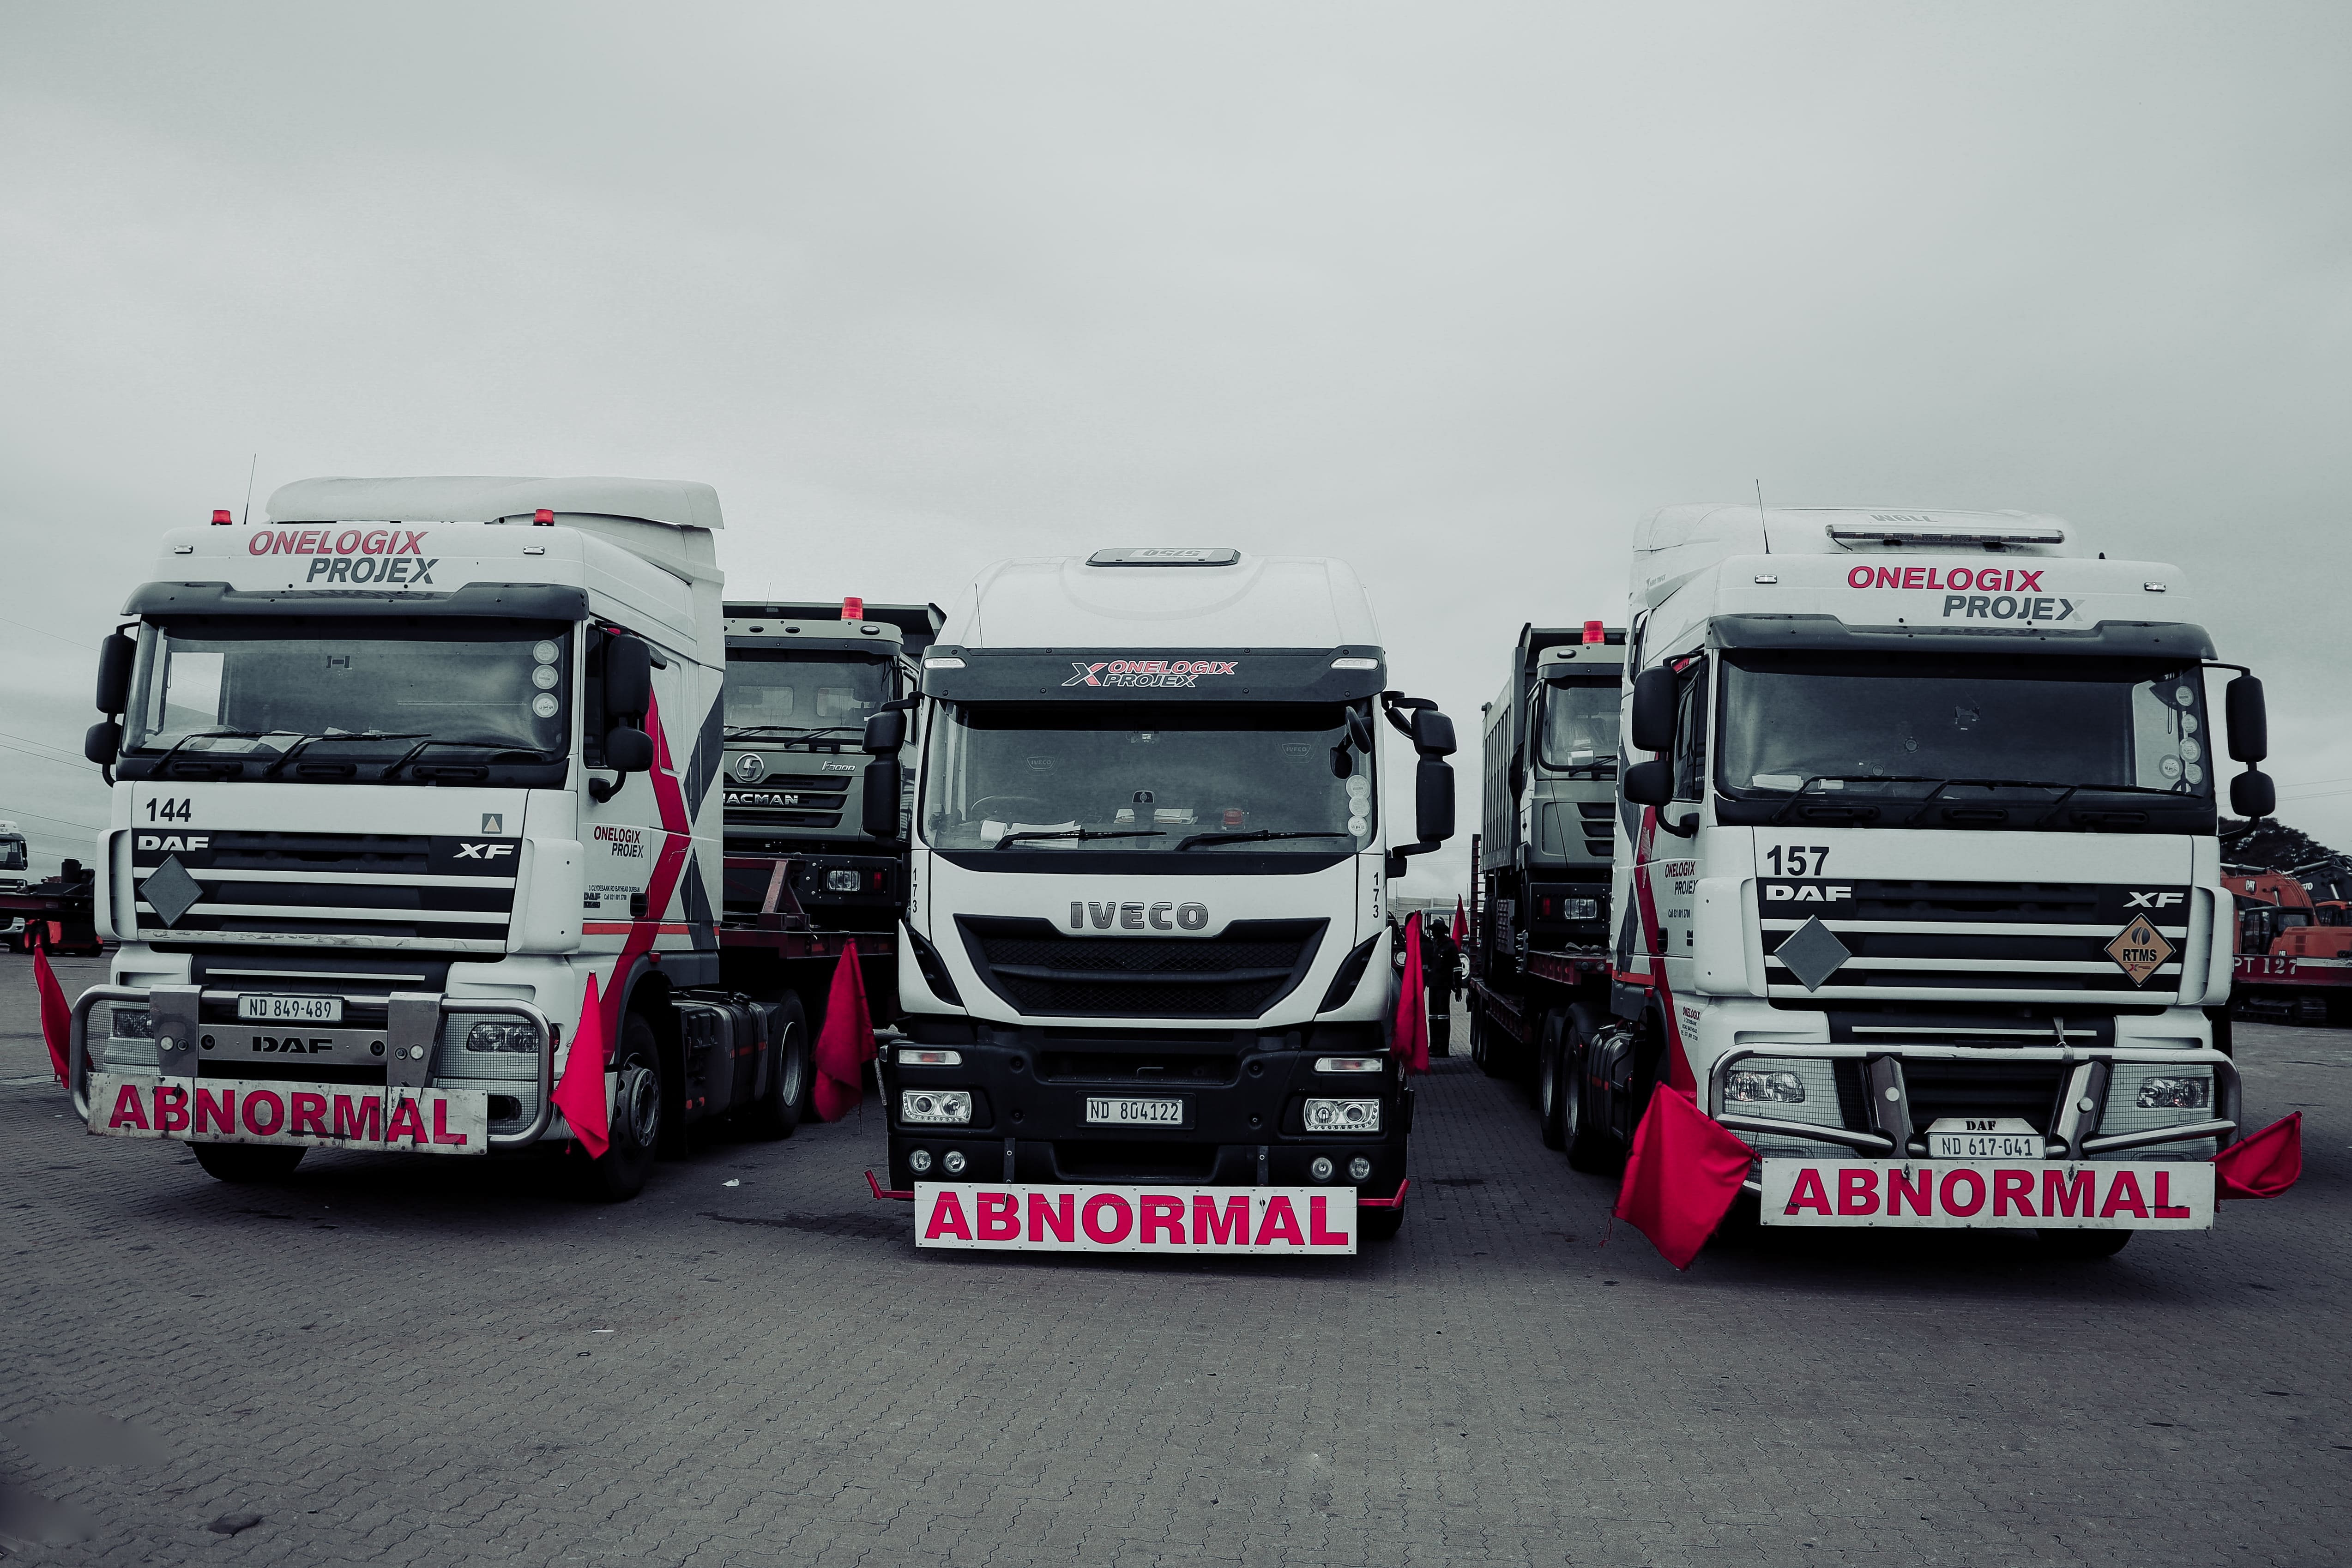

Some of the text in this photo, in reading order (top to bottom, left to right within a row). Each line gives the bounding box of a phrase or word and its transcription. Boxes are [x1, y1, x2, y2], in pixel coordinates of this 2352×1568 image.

[248, 530, 429, 555] ONELOGIX
[306, 557, 440, 584] PROJEX
[1847, 566, 2045, 592] ONELOGIX
[1942, 595, 2086, 622] PROJEX
[1107, 660, 1238, 675] ONELOGIX
[1102, 674, 1199, 688] PROJEX
[145, 797, 192, 822] 144
[138, 835, 209, 851] DAF
[594, 826, 641, 844] ONELOGIX
[452, 843, 515, 859] XF
[611, 843, 645, 858] PROJEX
[1767, 844, 1830, 876] 157
[1665, 861, 1696, 878] ONELOGIX
[1674, 880, 1699, 895] PROJEX
[1766, 885, 1851, 902] DAF
[2245, 879, 2256, 892] CAT
[584, 892, 601, 900] DAF
[2123, 892, 2184, 908] XF
[1070, 901, 1209, 930] IVECO
[2123, 948, 2157, 962] RTMS
[2263, 958, 2297, 975] 127
[250, 999, 332, 1019] ND 849-489
[1683, 1006, 1701, 1021] ONELOGIX
[252, 1036, 333, 1054] DAF
[107, 1084, 468, 1146] ABNORMAL
[1091, 1101, 1178, 1121] ND 804122
[1965, 1120, 1996, 1131] DAF
[1942, 1137, 2033, 1156] ND 617-041
[1782, 1168, 2191, 1219] ABNORMAL
[923, 1191, 1349, 1246] ABNORMAL
